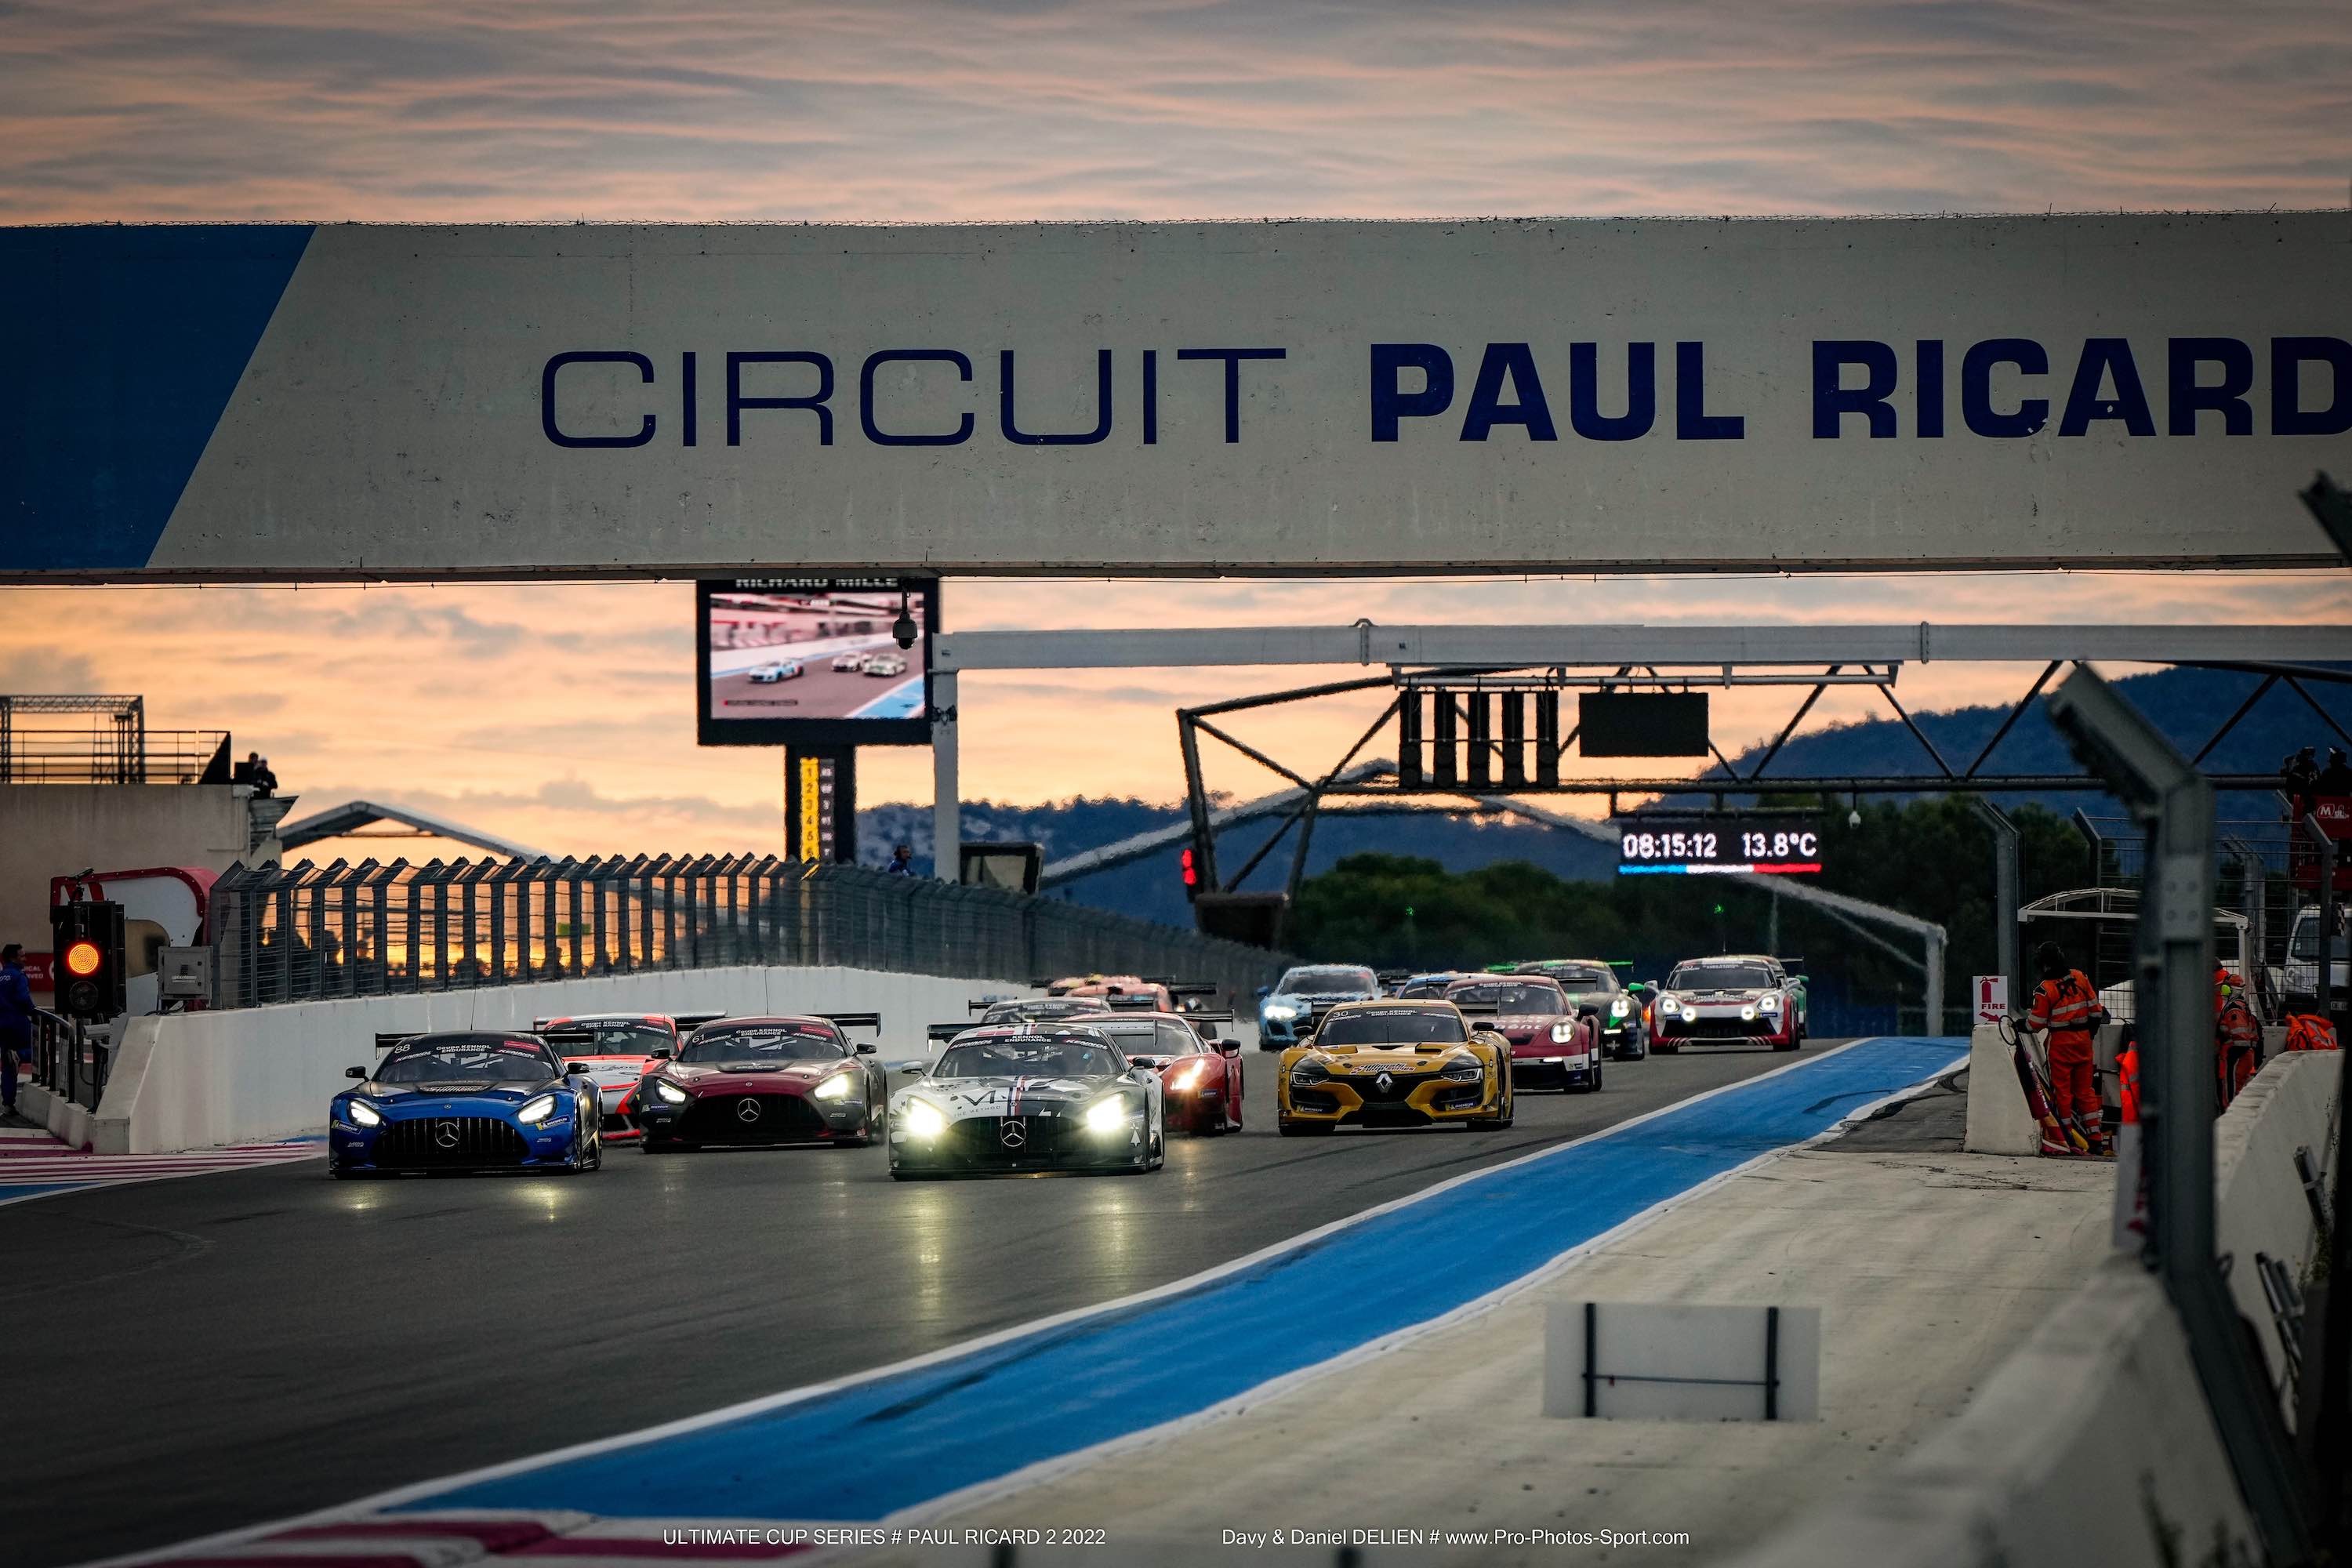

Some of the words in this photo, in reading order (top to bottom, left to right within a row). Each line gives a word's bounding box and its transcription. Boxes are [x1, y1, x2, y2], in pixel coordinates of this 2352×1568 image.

[541, 349, 1287, 448] CIRCUIT
[1372, 343, 1744, 442] PAUL
[1812, 336, 2352, 439] RICARD
[1622, 833, 1718, 858] 08:15:12
[1741, 833, 1817, 858] 13.8°C
[691, 1034, 705, 1044] 61
[394, 1044, 411, 1054] 88
[496, 1048, 535, 1059] KENNOL
[394, 1051, 432, 1063] KENNOL
[970, 1105, 1002, 1114] METHOD
[547, 1117, 568, 1126] MICHELIN
